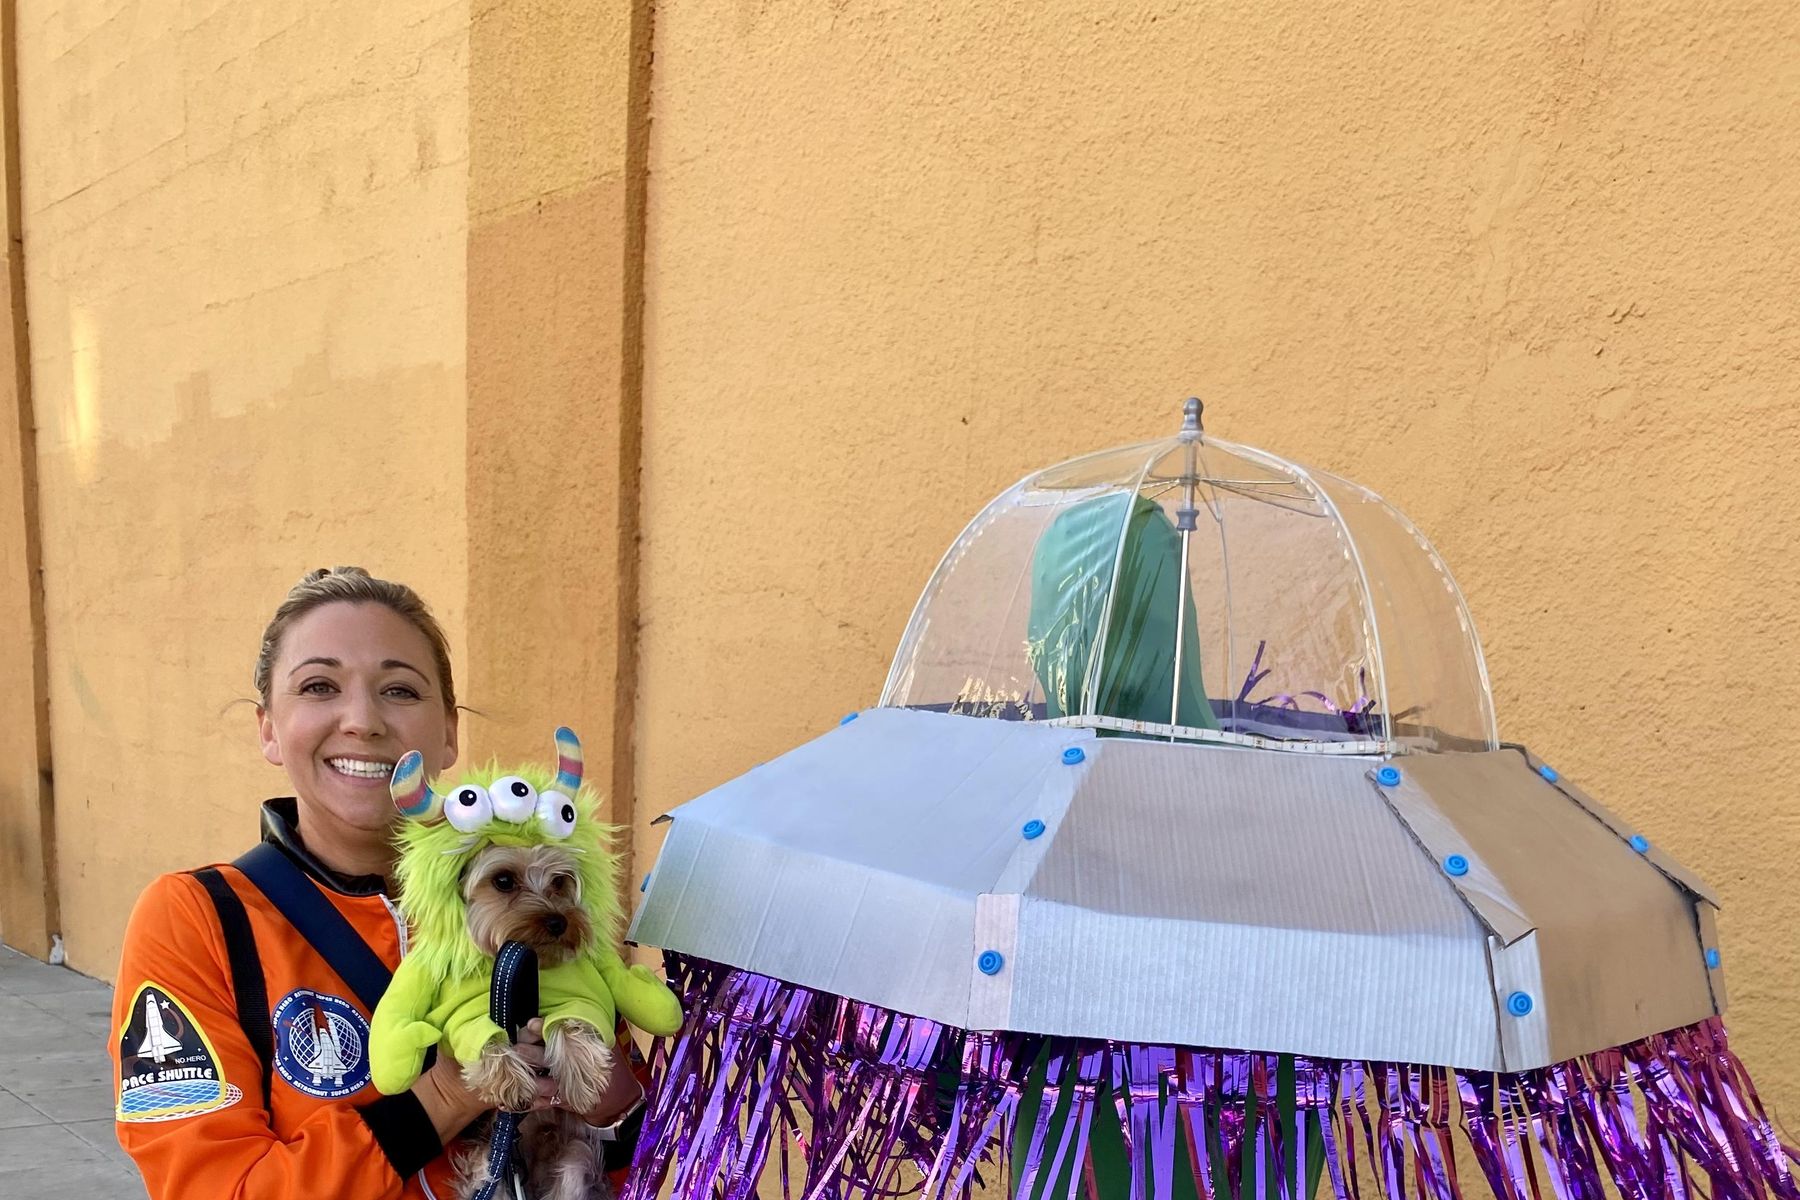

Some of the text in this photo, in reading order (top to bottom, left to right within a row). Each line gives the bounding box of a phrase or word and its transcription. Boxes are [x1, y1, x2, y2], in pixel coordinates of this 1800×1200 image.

[122, 1067, 213, 1091] PACE SHUTTLE
[330, 1088, 350, 1097] SUPER
[349, 1080, 365, 1092] HERO
